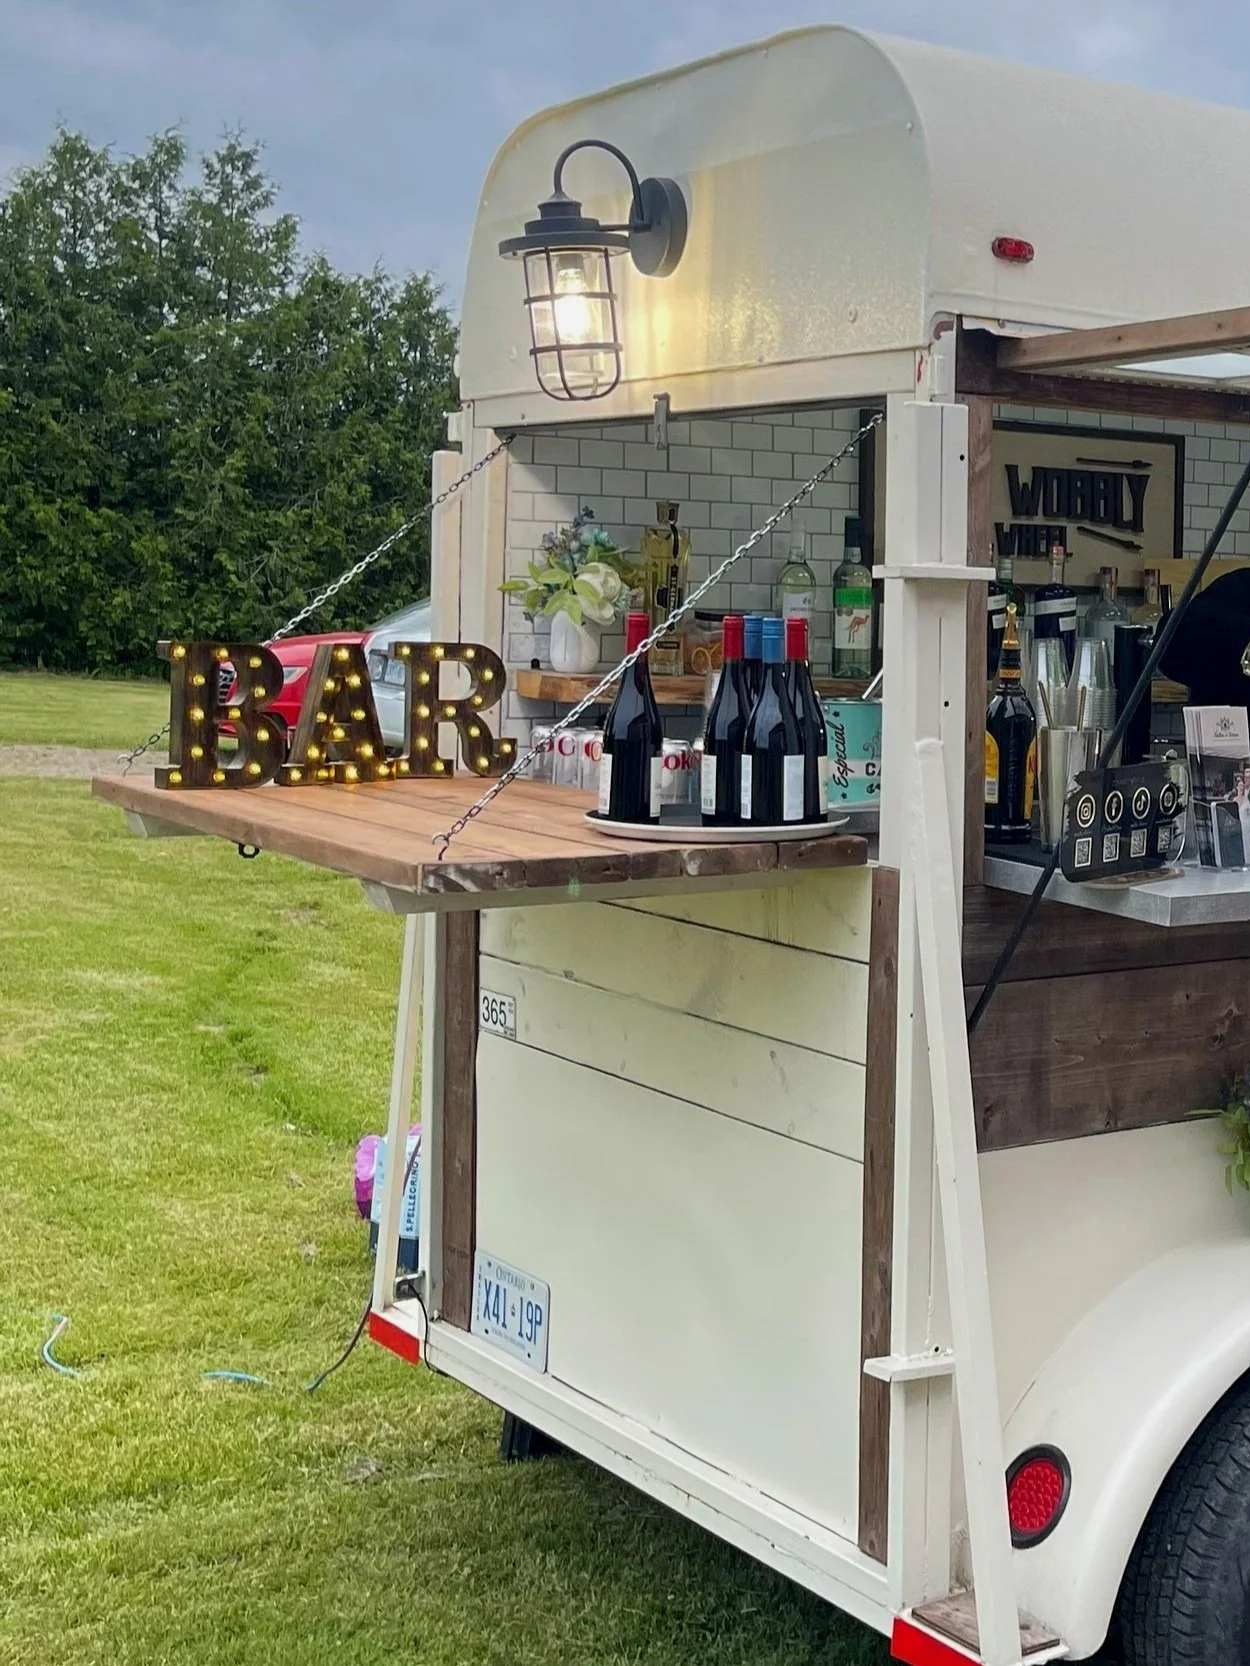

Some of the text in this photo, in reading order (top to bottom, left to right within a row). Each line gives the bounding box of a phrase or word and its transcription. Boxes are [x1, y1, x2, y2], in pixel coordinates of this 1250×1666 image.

[1005, 464, 1150, 532] WOBBLY
[155, 640, 517, 789] BAR
[826, 719, 855, 788] Especial
[482, 996, 507, 1028] 365
